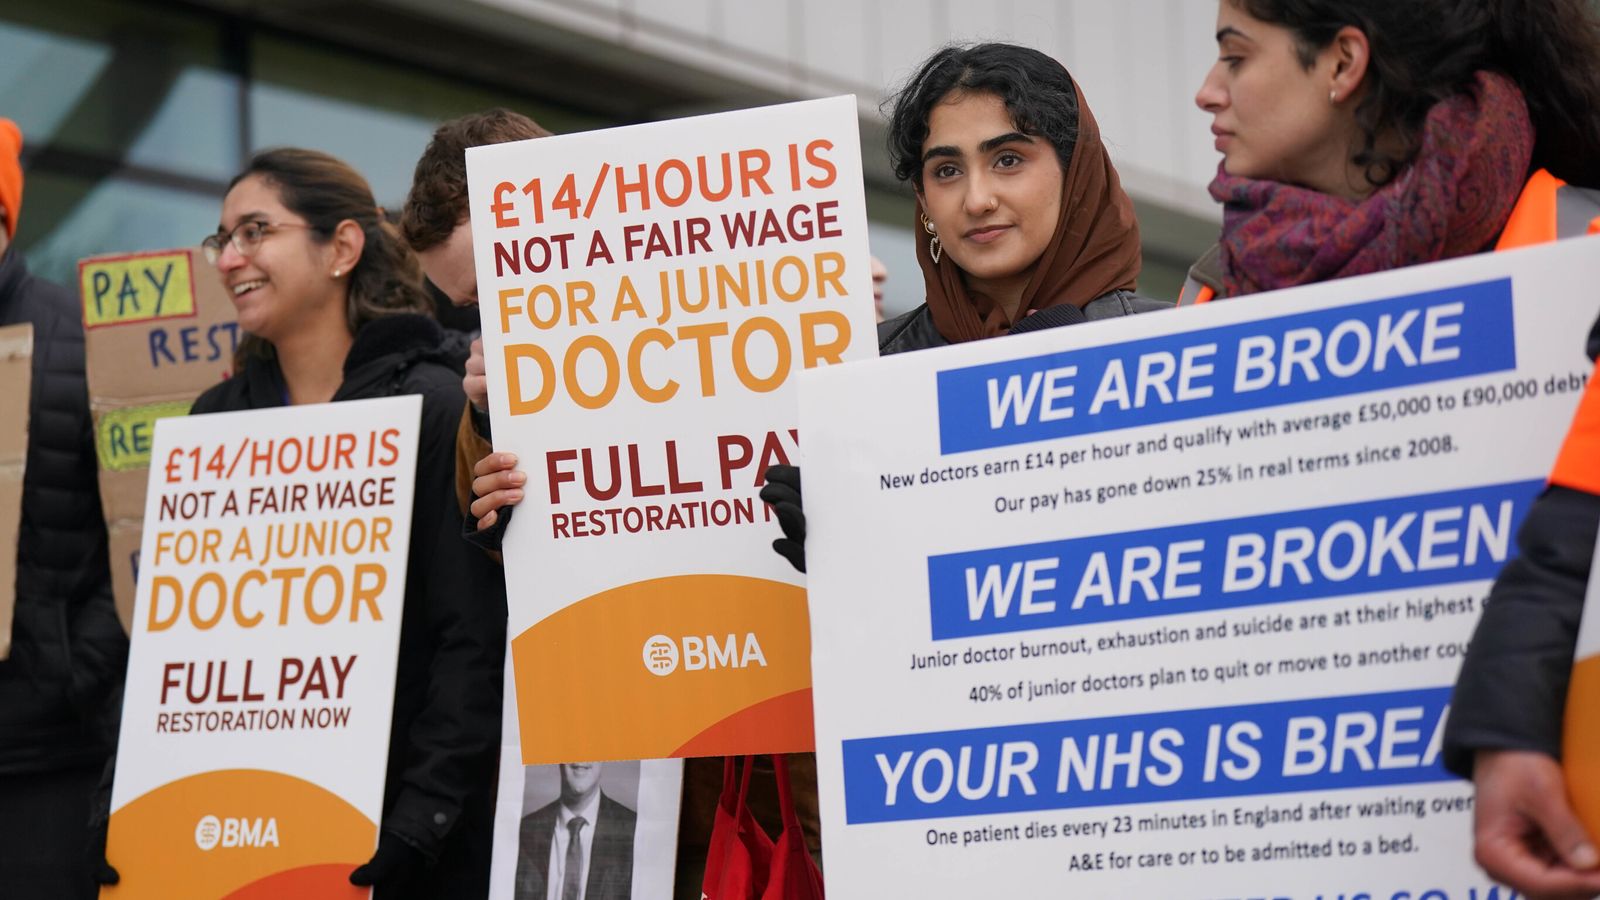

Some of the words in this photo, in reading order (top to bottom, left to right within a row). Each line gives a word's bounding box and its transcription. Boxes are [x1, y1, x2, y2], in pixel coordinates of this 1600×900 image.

[490, 148, 774, 229] £14/HOUR
[788, 139, 838, 191] IS
[493, 233, 576, 277] NOT
[585, 230, 615, 267] A
[623, 217, 713, 262] FAIR
[721, 200, 843, 249] WAGE
[92, 263, 174, 316] PAY
[498, 280, 599, 334] FOR
[611, 275, 647, 322] A
[656, 251, 849, 326] JUNIOR
[503, 310, 853, 417] DOCTOR
[986, 366, 1079, 430] WE
[1089, 343, 1218, 415] ARE
[1233, 302, 1464, 394] BROKE
[165, 433, 357, 484] £14/HOUR
[367, 428, 401, 467] IS
[546, 439, 704, 504] FULL
[717, 428, 799, 490] PA
[879, 472, 915, 491] New
[919, 460, 979, 486] doctors
[983, 457, 1020, 477] earn
[1025, 450, 1054, 471] £14
[1059, 450, 1087, 469] per
[1092, 443, 1131, 461] hour
[1136, 434, 1168, 455] and
[1173, 425, 1233, 452] qualify
[1237, 418, 1277, 441] with
[1282, 410, 1352, 434] average
[1358, 395, 1431, 424] £50,000
[1436, 395, 1456, 412] to
[1462, 378, 1538, 409] £90,000
[159, 490, 216, 521] NOT
[221, 490, 239, 517] A
[248, 484, 308, 515] FAIR
[316, 477, 396, 508] WAGE
[994, 496, 1025, 513] Our
[1030, 494, 1059, 513] pay
[1063, 486, 1092, 504] has
[1097, 482, 1138, 505] gone
[1143, 475, 1191, 494] down
[1197, 467, 1232, 487] 25%
[1237, 464, 1254, 481] in
[1259, 456, 1292, 477] real
[1297, 453, 1350, 473] terms
[1356, 445, 1401, 466] since
[1408, 434, 1459, 458] 2008.
[154, 529, 222, 566] FOR
[230, 527, 253, 561] A
[259, 516, 393, 566] JUNIOR
[551, 497, 755, 539] RESTORATION
[965, 558, 1059, 622] WE
[1071, 540, 1203, 611] ARE
[1222, 500, 1514, 594] BROKEN
[146, 563, 388, 632] DOCTOR
[682, 632, 767, 671] BMA
[910, 650, 958, 670] Junior
[962, 646, 1016, 665] doctor
[1020, 638, 1092, 659] burnout,
[1097, 627, 1190, 651] exhaustion
[1195, 620, 1227, 641] and
[1232, 613, 1294, 637] suicide
[1299, 614, 1327, 630] are
[1333, 609, 1352, 627] at
[1356, 602, 1400, 624] their
[1405, 596, 1474, 622] highest
[160, 659, 265, 705] FULL
[278, 655, 358, 701] PAY
[969, 684, 1002, 703] 40%
[1007, 680, 1024, 701] of
[1028, 678, 1077, 702] junior
[1081, 673, 1144, 693] doctors
[1149, 667, 1186, 690] plan
[1191, 667, 1209, 682] to
[1214, 661, 1250, 682] quit
[1254, 661, 1272, 676] or
[1278, 655, 1327, 673] move
[1332, 653, 1352, 669] to
[1357, 644, 1430, 667] another
[157, 709, 296, 733] RESTORATION
[301, 707, 352, 729] NOW
[875, 740, 1039, 806] YOUR
[1056, 728, 1185, 794] NHS
[1203, 720, 1263, 782] IS
[222, 817, 280, 848] BMA
[926, 829, 958, 846] One
[963, 826, 1020, 847] patient
[1024, 820, 1058, 841] dies
[1062, 819, 1108, 839] every
[1112, 815, 1133, 834] 23
[1138, 811, 1207, 832] minutes
[1211, 809, 1228, 827] in
[1233, 802, 1304, 829] England
[1309, 800, 1352, 821] after
[1357, 796, 1426, 819] waiting
[1431, 796, 1474, 813] over
[1068, 853, 1104, 872] A&E
[1108, 850, 1133, 869] for
[1137, 852, 1173, 868] care
[1178, 851, 1197, 866] or
[1201, 845, 1220, 864] to
[1224, 841, 1246, 864] be
[1251, 838, 1333, 862] admitted
[1338, 839, 1358, 857] to
[1362, 840, 1373, 856] a
[1378, 833, 1419, 856] bed.
